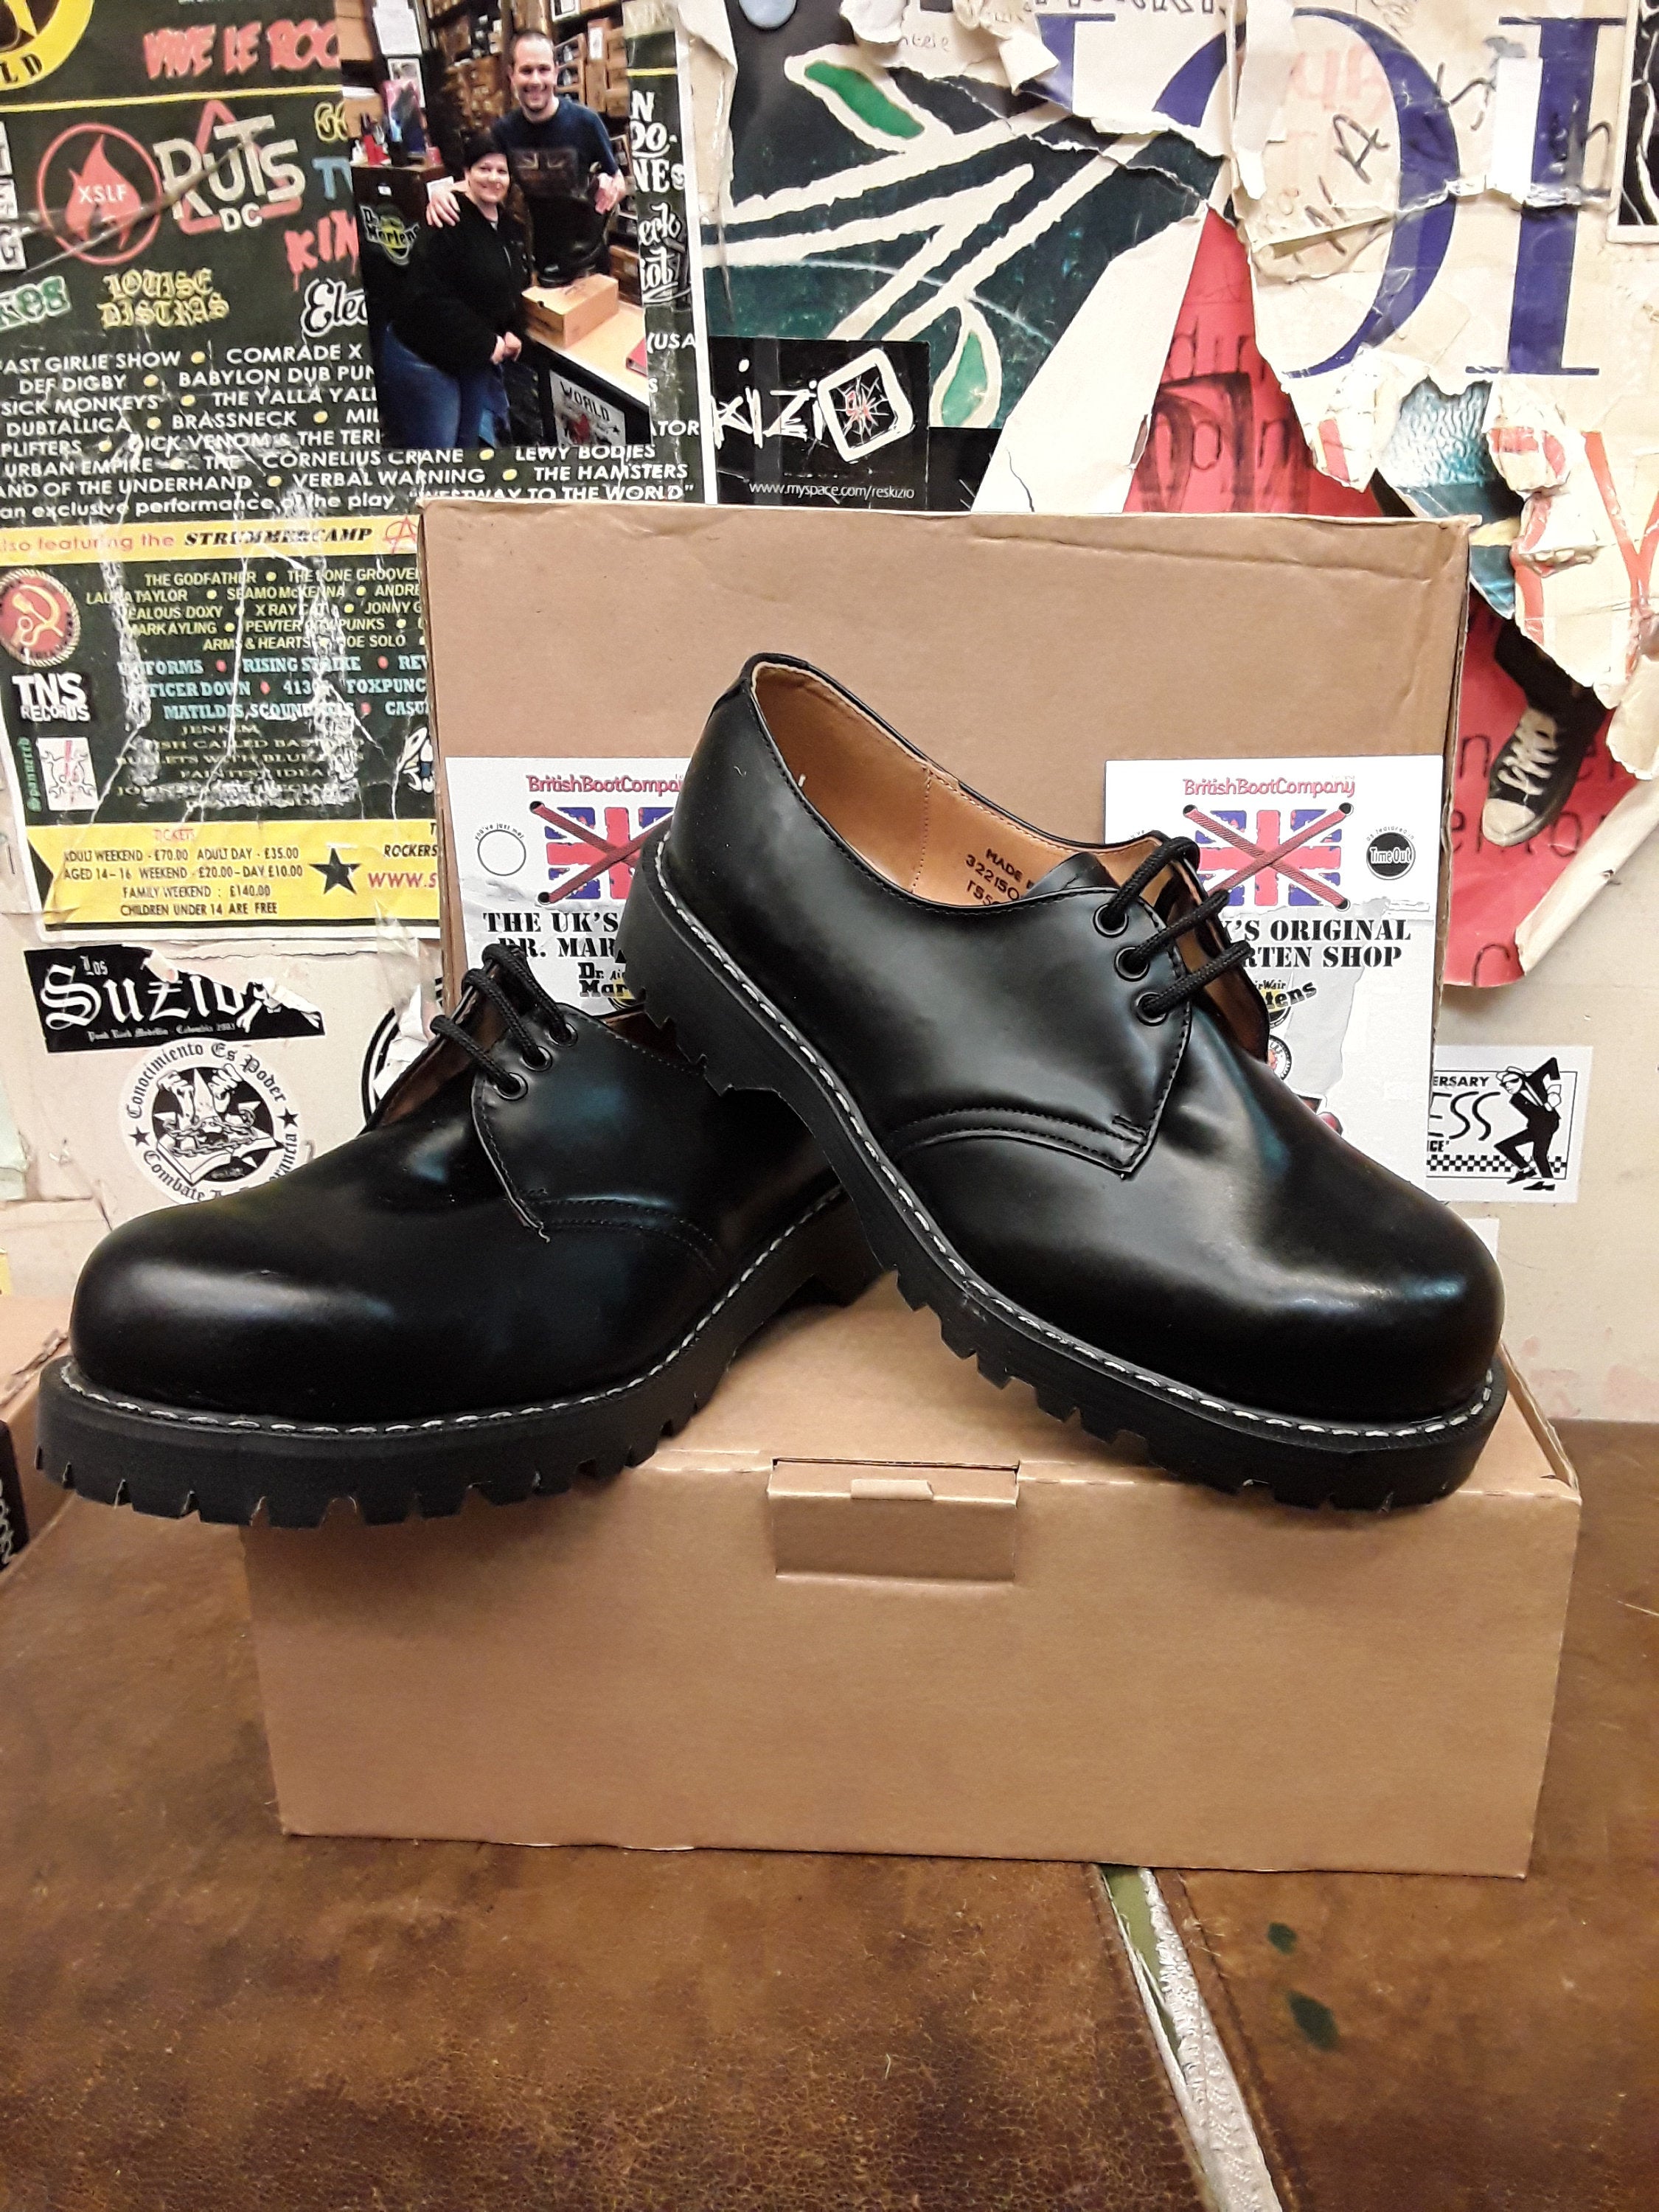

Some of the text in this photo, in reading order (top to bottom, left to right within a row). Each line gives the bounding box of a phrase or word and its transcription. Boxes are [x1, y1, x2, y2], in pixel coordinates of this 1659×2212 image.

[152, 114, 306, 220] RUTS
[78, 185, 126, 205] XSLF
[218, 202, 263, 233] DC
[103, 270, 215, 299] LOUISE
[97, 298, 230, 329] DISTRAS
[0, 349, 181, 375] AST GIRLIE SHOW
[226, 343, 363, 366] COMRADE X
[18, 374, 128, 396] DEF DIGBY
[178, 366, 281, 388] BABYLON
[288, 366, 331, 385] DUB
[0, 393, 161, 418] SICK MONKEYS
[212, 390, 250, 407] THE
[254, 387, 323, 406] YALLA
[171, 409, 298, 431] BRASSNECK
[296, 429, 335, 447] THE
[203, 447, 464, 471] THE CORNELIUS CRANE
[515, 444, 656, 462] LEWY BODIES
[4, 456, 153, 480] URBAN EMPIRE
[533, 464, 689, 481] THE HAMSTERS
[42, 476, 253, 498] OF THE UNDERHAND
[292, 469, 486, 488] VERBAL WARNING
[749, 481, 916, 500] www.myspace.com/reskizio
[31, 501, 130, 521] exclusive
[347, 490, 396, 511] play
[526, 487, 557, 501] TO
[560, 485, 599, 501] THE
[0, 536, 31, 553] lso
[38, 532, 134, 554] featurng
[140, 532, 175, 548] the
[144, 571, 257, 587] THE GODFATHER
[287, 569, 313, 583] THE
[133, 588, 189, 604] TAYLOR
[124, 605, 224, 621] EALOUS DOXY
[267, 602, 298, 617] RAY
[364, 600, 411, 616] JONNY
[244, 617, 385, 633] PEWTER PUNKS
[244, 636, 313, 650] & HEARTS
[369, 633, 406, 648] SOLO
[242, 656, 298, 674] RISING
[12, 672, 87, 707] TNS
[1182, 776, 1356, 799] BritishBootCompany
[94, 849, 144, 862] WEEKEND
[154, 849, 189, 861] £70.00
[196, 847, 299, 860] ADULT DAY £35.00
[63, 868, 93, 880] AGED
[139, 866, 188, 880] WEEKEND
[268, 864, 304, 877] £10.00
[985, 848, 1023, 883] MADE
[162, 885, 212, 898] WEEKEND
[229, 884, 271, 897] £140.00
[120, 902, 279, 917] CHILDREN UNDER 14 ARE FREE
[482, 911, 619, 933] THE UK'S
[1270, 918, 1412, 942] ORIGINAL
[79, 955, 108, 976] Los
[1322, 945, 1403, 968] SHOP
[577, 961, 605, 979] Dr.
[126, 1042, 288, 1119] Conocimiento Es Poder
